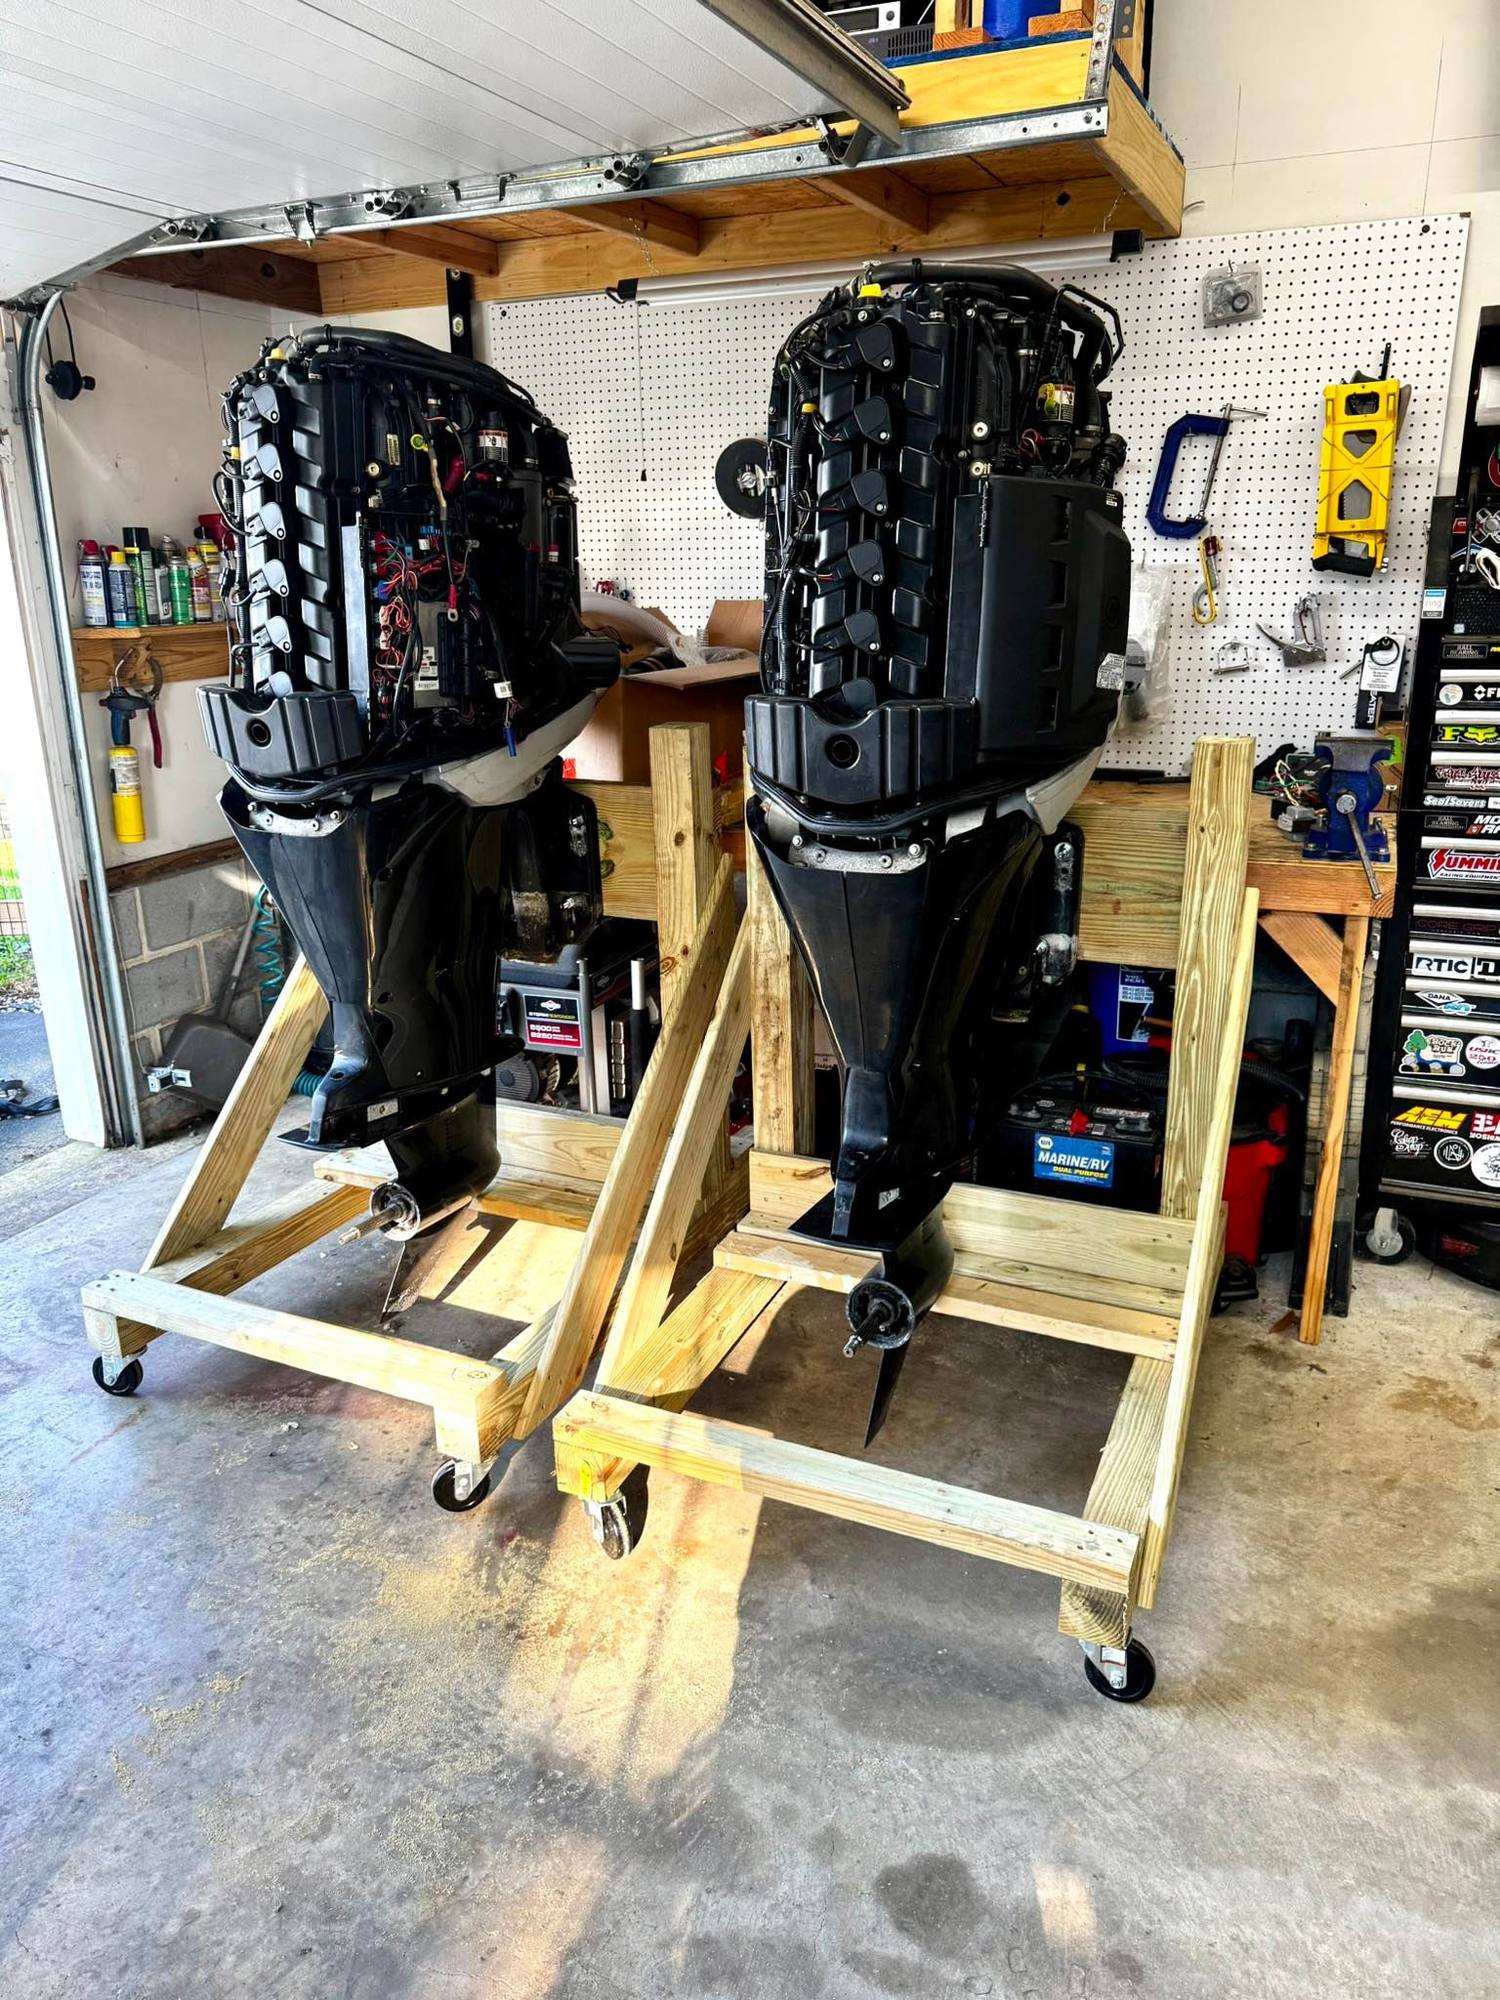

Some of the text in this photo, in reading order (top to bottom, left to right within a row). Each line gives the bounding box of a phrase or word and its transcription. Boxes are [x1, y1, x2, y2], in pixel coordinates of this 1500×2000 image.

[1415, 956, 1469, 974] RTIC
[1428, 993, 1451, 1001] DANA
[1038, 1151, 1109, 1171] MARINE/RV
